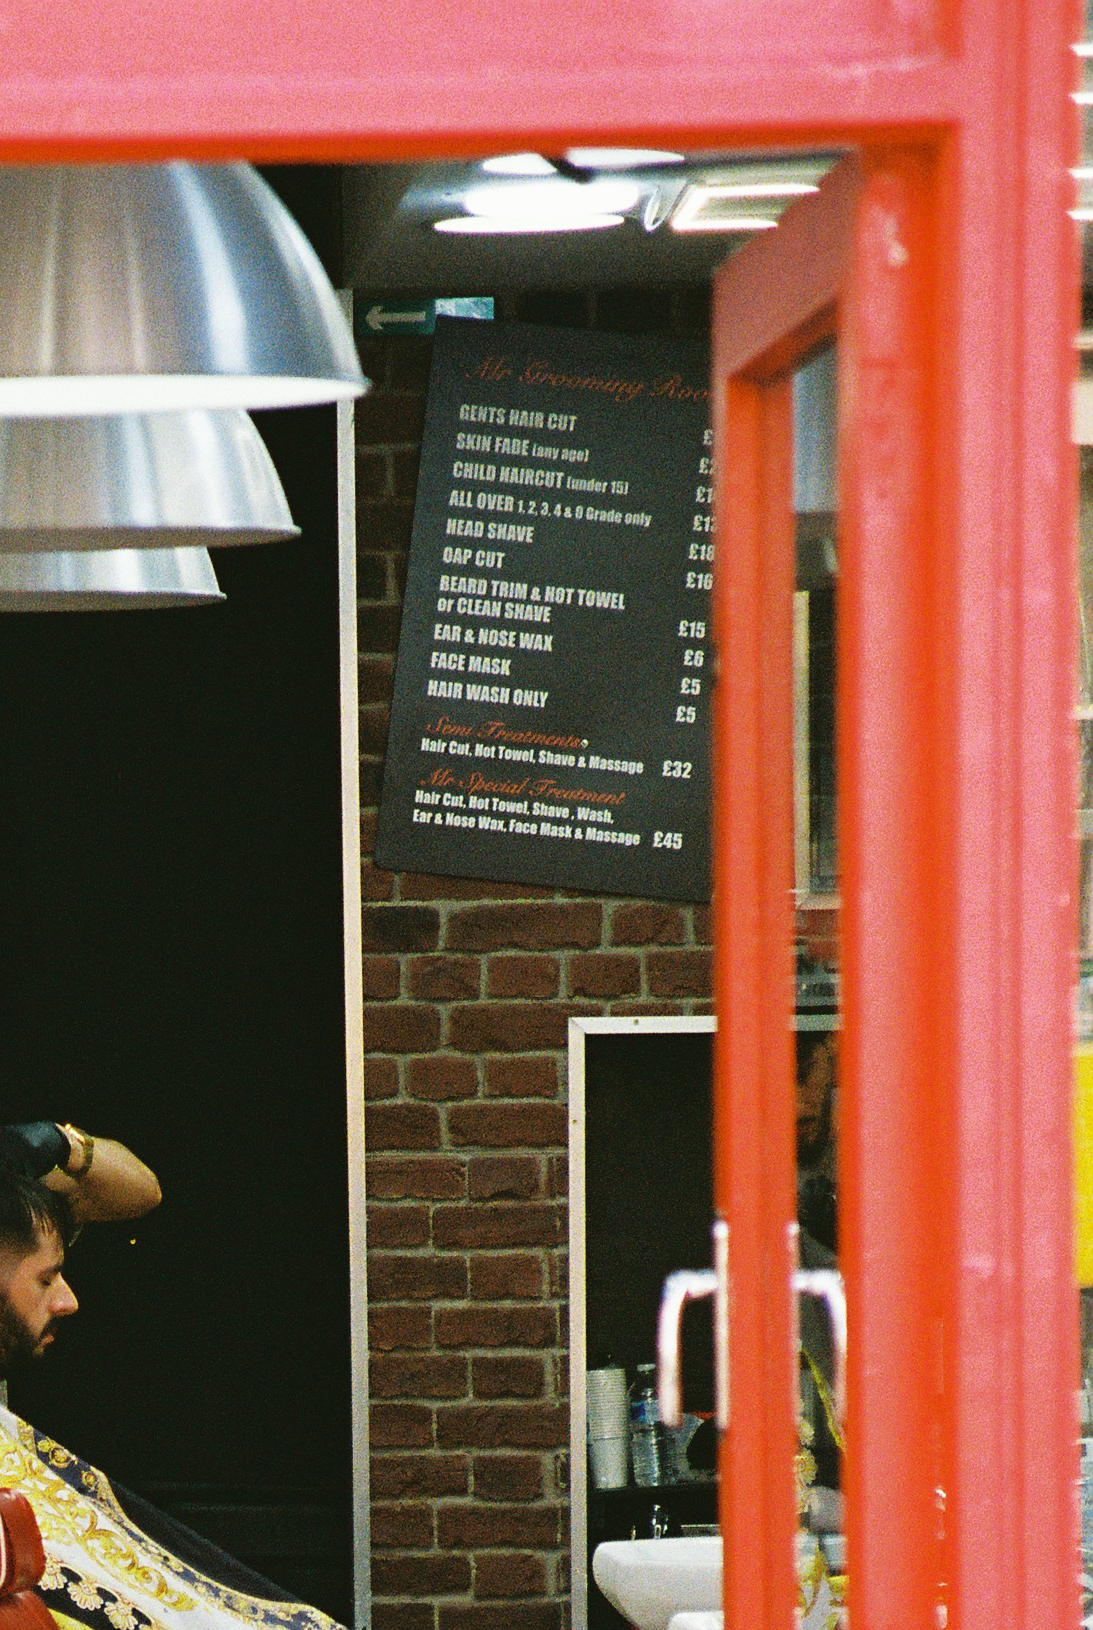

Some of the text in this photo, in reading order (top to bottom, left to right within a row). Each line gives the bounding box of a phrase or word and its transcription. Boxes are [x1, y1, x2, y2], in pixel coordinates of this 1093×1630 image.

[458, 403, 578, 433] GENTS HAIR CUT
[455, 431, 492, 453] SKIN
[494, 435, 530, 457] FADE
[452, 460, 497, 482] CHILD
[499, 466, 565, 489] HAIRCUT
[449, 489, 474, 508] ALL
[476, 492, 515, 513] OVER
[586, 506, 623, 525] Grade
[624, 511, 652, 529] only
[446, 517, 485, 538] HEAD
[487, 521, 535, 544] SHAVE
[442, 546, 473, 566] OAP
[475, 550, 507, 570] CUT
[439, 574, 626, 611] BEARD TRIM & HOT TOWEL
[437, 596, 706, 639] or CLEAN SHAVE £15
[433, 623, 705, 668] EAR & NOSE WAX £6
[430, 651, 701, 696] FACE MASK £5
[427, 679, 697, 724] HAIR WASH ONLY £5
[476, 720, 581, 749] Treatments
[420, 737, 447, 753] Hair
[474, 743, 496, 760] Hot
[538, 749, 576, 768] Shave
[577, 755, 587, 768] &
[588, 755, 645, 775] Massage
[662, 759, 693, 779] £32
[414, 789, 441, 806] Hair
[468, 794, 490, 811] Hot
[532, 801, 570, 819] Shave
[458, 770, 530, 797] Special
[528, 779, 627, 806] Treatment
[412, 808, 434, 824] Ear
[434, 812, 443, 825] &
[445, 812, 477, 829] Nose
[508, 818, 538, 836] Face
[539, 821, 573, 839] Mask
[574, 827, 583, 840] &
[585, 826, 641, 847] Massage
[652, 830, 684, 850] £45
